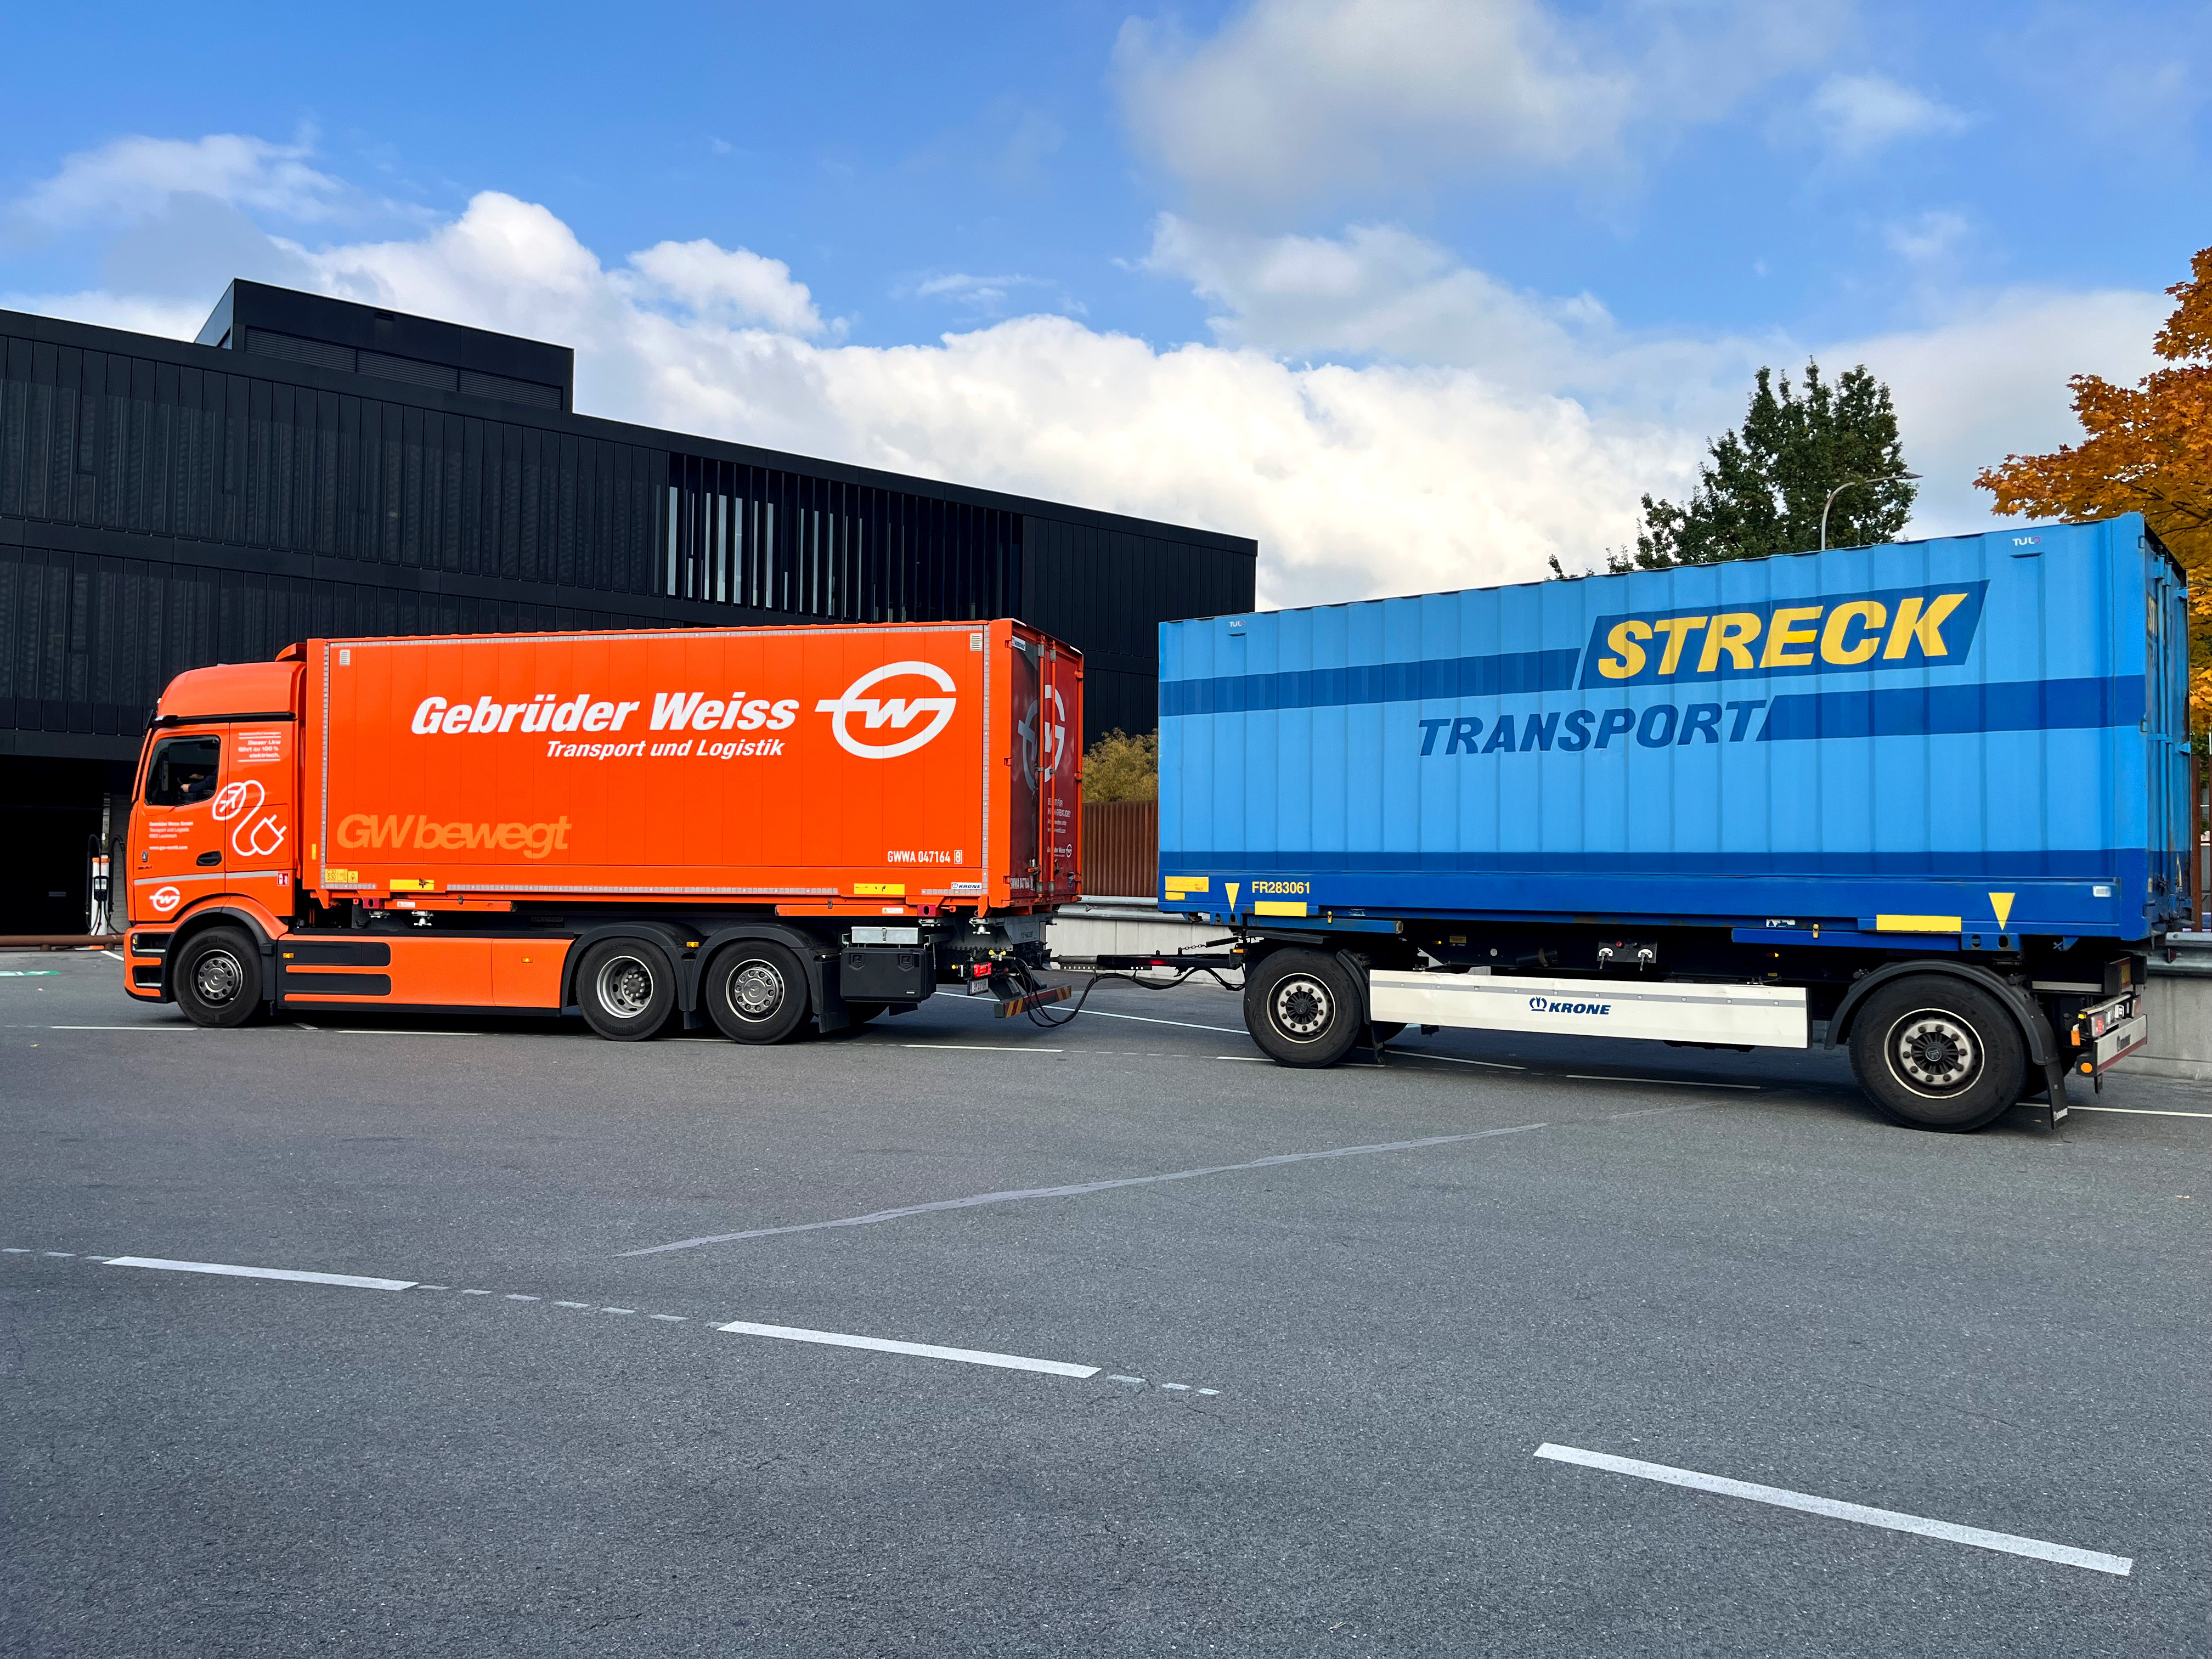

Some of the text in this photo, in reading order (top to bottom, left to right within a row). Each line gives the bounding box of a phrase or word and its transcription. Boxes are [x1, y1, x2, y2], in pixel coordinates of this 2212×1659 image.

[1598, 592, 1970, 679] STRECK
[411, 691, 799, 735] Gebrüder Weiss
[1418, 698, 1767, 756] TRANSPORT
[546, 738, 786, 761] Transport und Logistik
[887, 850, 916, 863] GWWA
[918, 850, 951, 863] 047164
[1252, 881, 1310, 894] FR283061
[1548, 1002, 1611, 1015] KRONE
